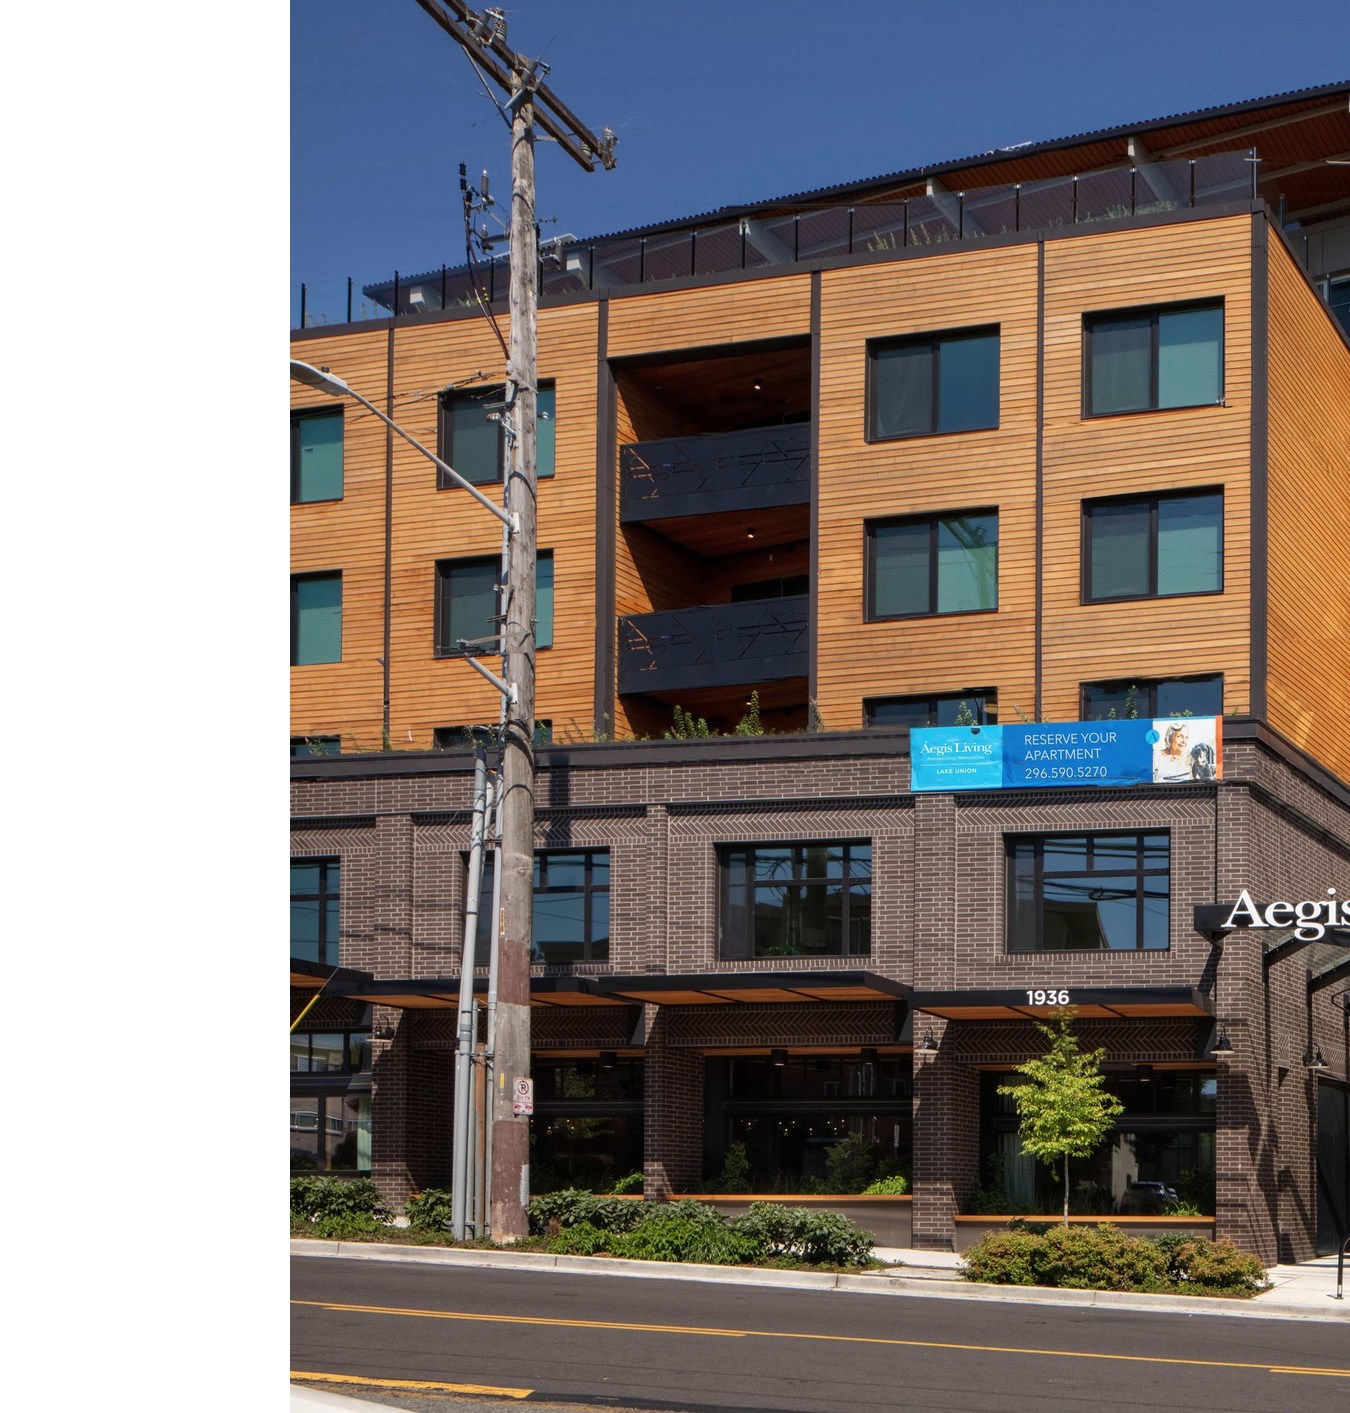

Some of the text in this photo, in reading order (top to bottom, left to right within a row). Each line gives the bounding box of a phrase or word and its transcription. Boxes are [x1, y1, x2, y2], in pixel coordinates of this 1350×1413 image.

[1024, 731, 1117, 746] RESERVE YOUR
[955, 742, 993, 755] Living
[1024, 748, 1102, 761] APARTMENT
[1025, 765, 1107, 779] 296.590.5270
[1026, 990, 1070, 1005] 1936
